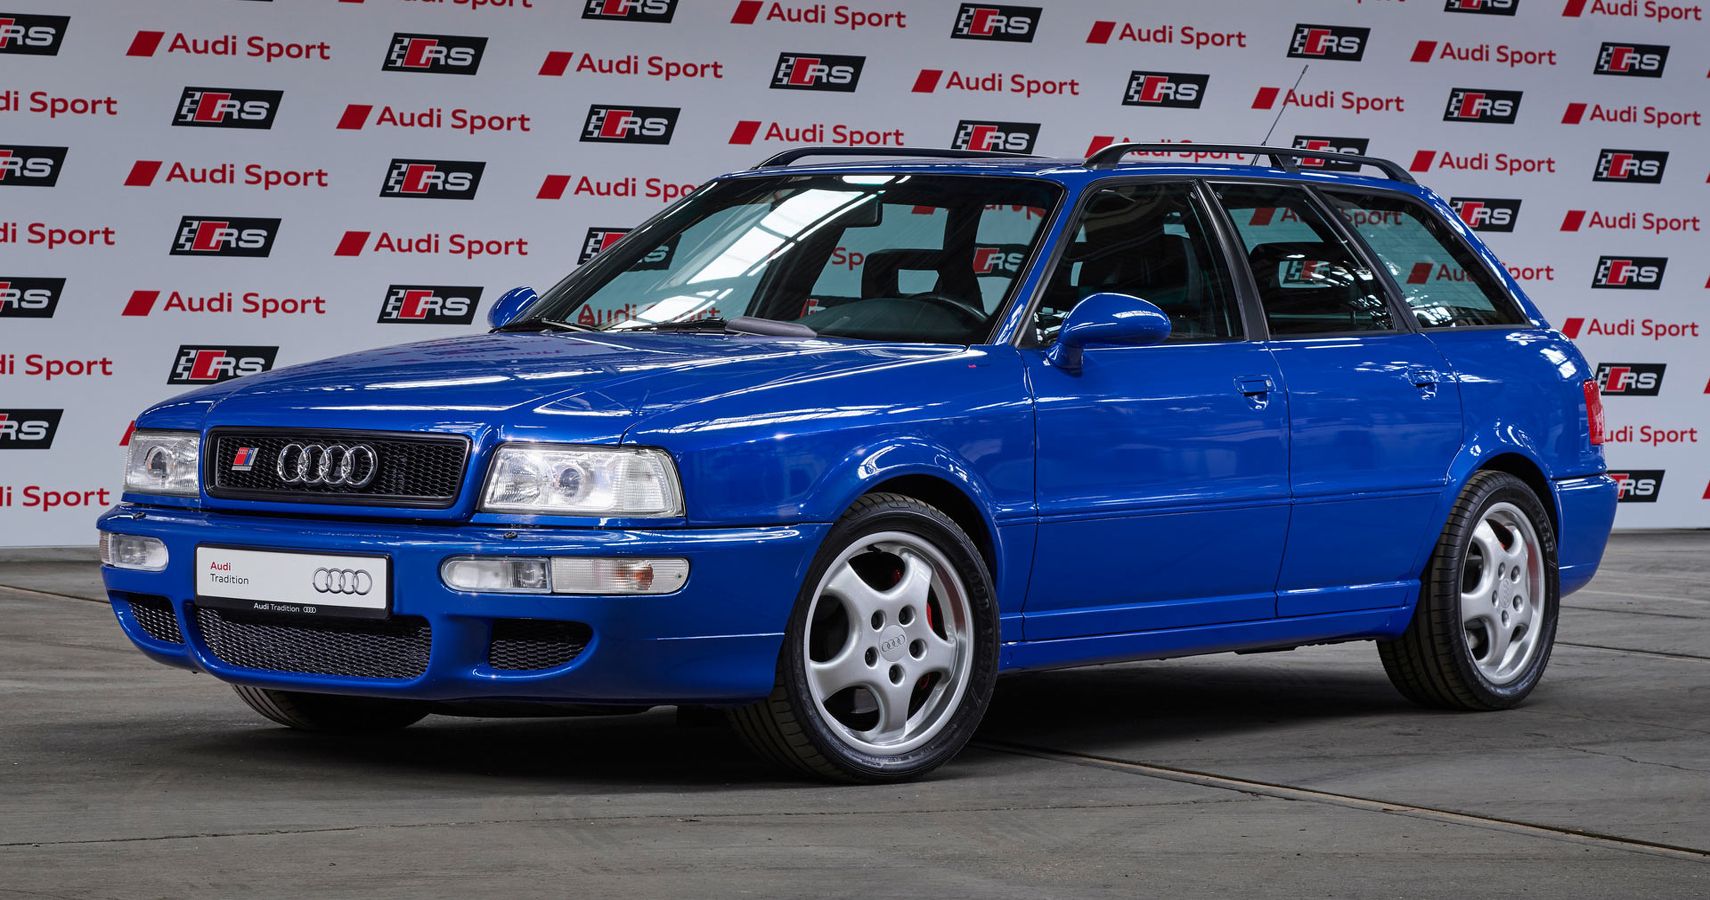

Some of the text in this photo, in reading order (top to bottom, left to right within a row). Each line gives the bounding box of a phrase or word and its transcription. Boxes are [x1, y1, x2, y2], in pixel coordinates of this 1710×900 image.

[766, 2, 905, 30] Audi Sport
[1590, 0, 1701, 22] Audi Sport
[983, 14, 1031, 34] RS
[0, 24, 56, 47] RS
[1119, 23, 1246, 49] Audi Sport
[1316, 35, 1360, 53] RS
[168, 32, 330, 63] Audi Sport
[419, 45, 475, 66] RS
[1440, 42, 1556, 66] Audi Sport
[576, 51, 722, 81] Audi Sport
[1621, 52, 1661, 70] RS
[804, 64, 854, 84] RS
[945, 70, 1079, 97] Audi Sport
[1153, 82, 1198, 100] RS
[1282, 88, 1404, 113] Audi Sport
[30, 91, 117, 119] Sport
[211, 99, 270, 120] RS
[1471, 98, 1513, 116] RS
[1590, 104, 1701, 128] Audi Sport
[377, 105, 529, 134] Audi Sport
[615, 116, 668, 136] RS
[764, 122, 904, 147] Audi Sport
[981, 131, 1030, 151] RS
[1439, 151, 1556, 176] Audi Sport
[1620, 159, 1660, 176] RS
[166, 161, 327, 192] Audi Sport
[417, 171, 473, 191] RS
[574, 176, 697, 203] Audi Spo
[1472, 207, 1513, 226] RS
[1589, 211, 1700, 235] Audi Sport
[27, 223, 115, 249] Sport
[209, 228, 267, 248] RS
[373, 231, 528, 260] Audi Sport
[1501, 263, 1555, 281] port
[1618, 265, 1658, 282] RS
[163, 290, 326, 319] Audi Sport
[414, 296, 470, 316] RS
[1587, 319, 1699, 341] Audi Sport
[24, 353, 113, 381] Sport
[207, 356, 266, 377] RS
[1617, 372, 1658, 390] RS
[1604, 425, 1698, 447] udi Sport
[22, 484, 110, 512] Sport
[1618, 479, 1657, 496] RS
[210, 561, 232, 572] Audi
[210, 573, 250, 585] Tradition
[253, 602, 300, 613] Audi Tradition
